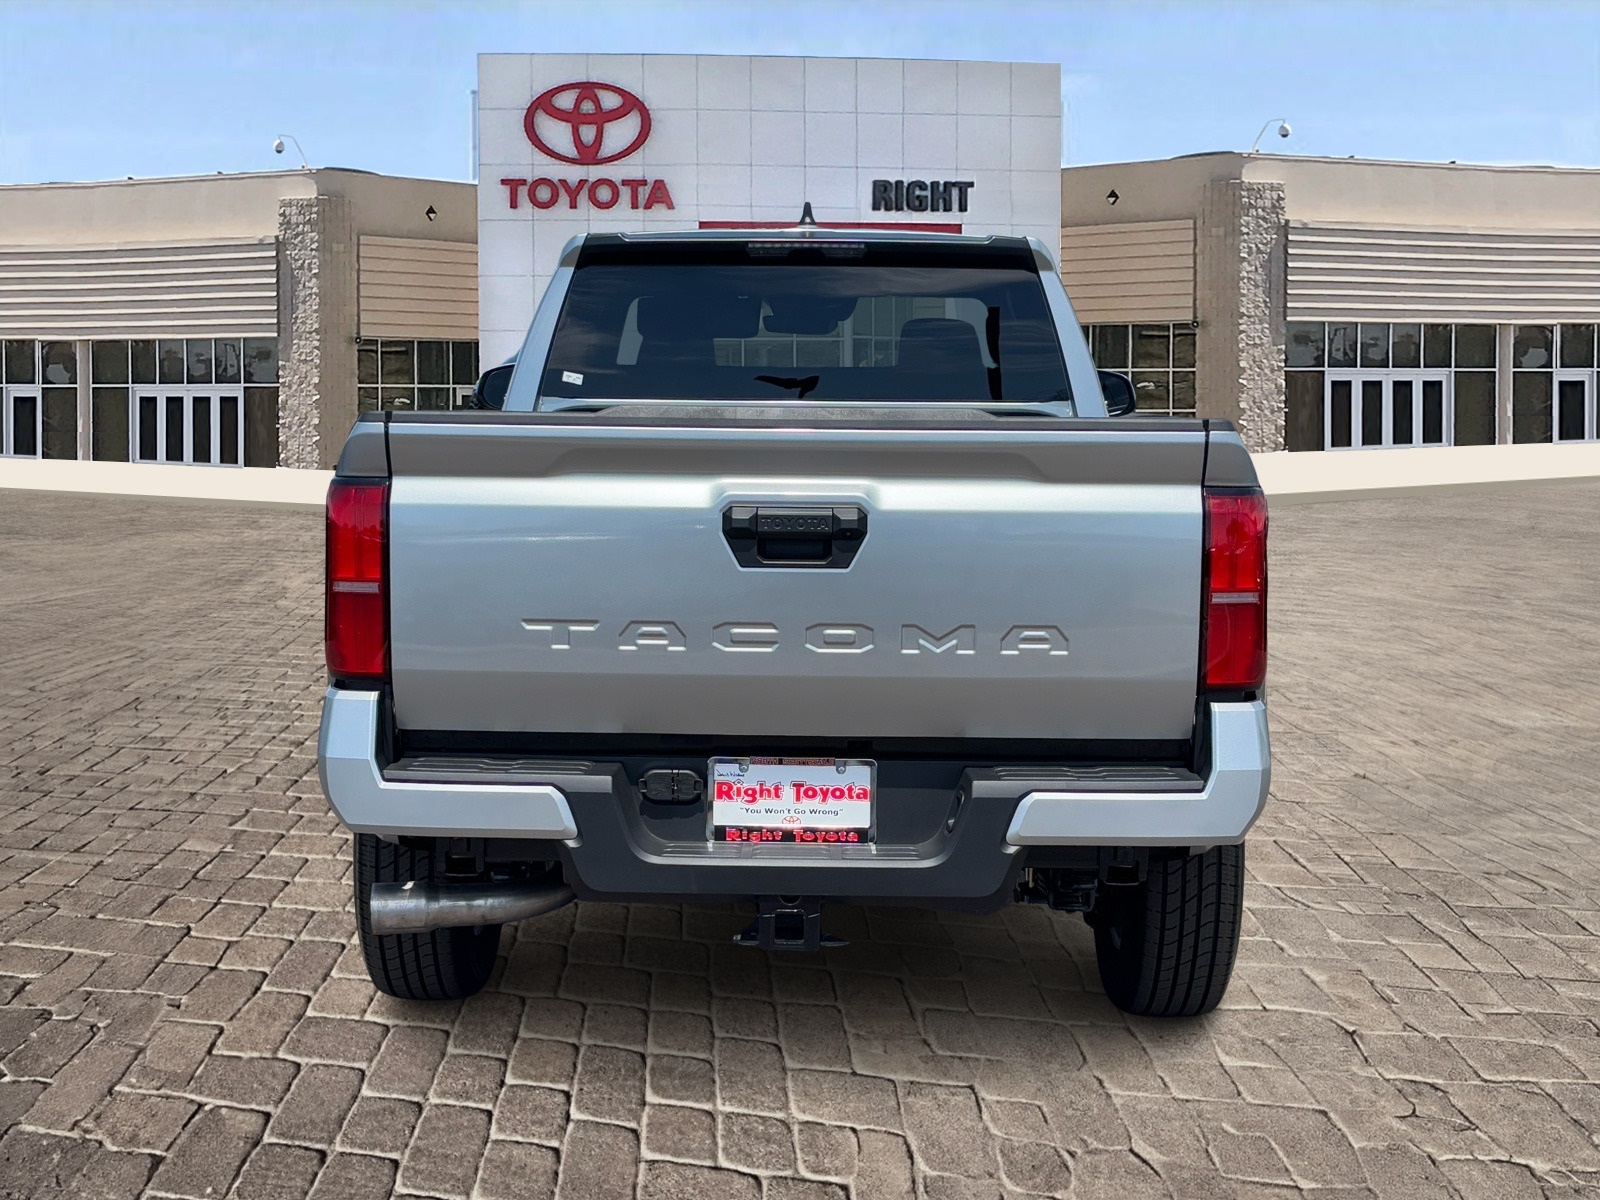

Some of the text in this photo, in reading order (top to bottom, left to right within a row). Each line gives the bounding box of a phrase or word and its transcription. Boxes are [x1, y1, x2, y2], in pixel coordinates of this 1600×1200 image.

[501, 178, 675, 210] TOYOTA
[871, 179, 974, 213] RIGHT
[761, 517, 829, 531] TOYOTA
[521, 618, 1069, 655] TACOMA
[715, 780, 870, 805] Right Toyota
[764, 807, 792, 815] Won't
[726, 827, 859, 843] Right Toyota
